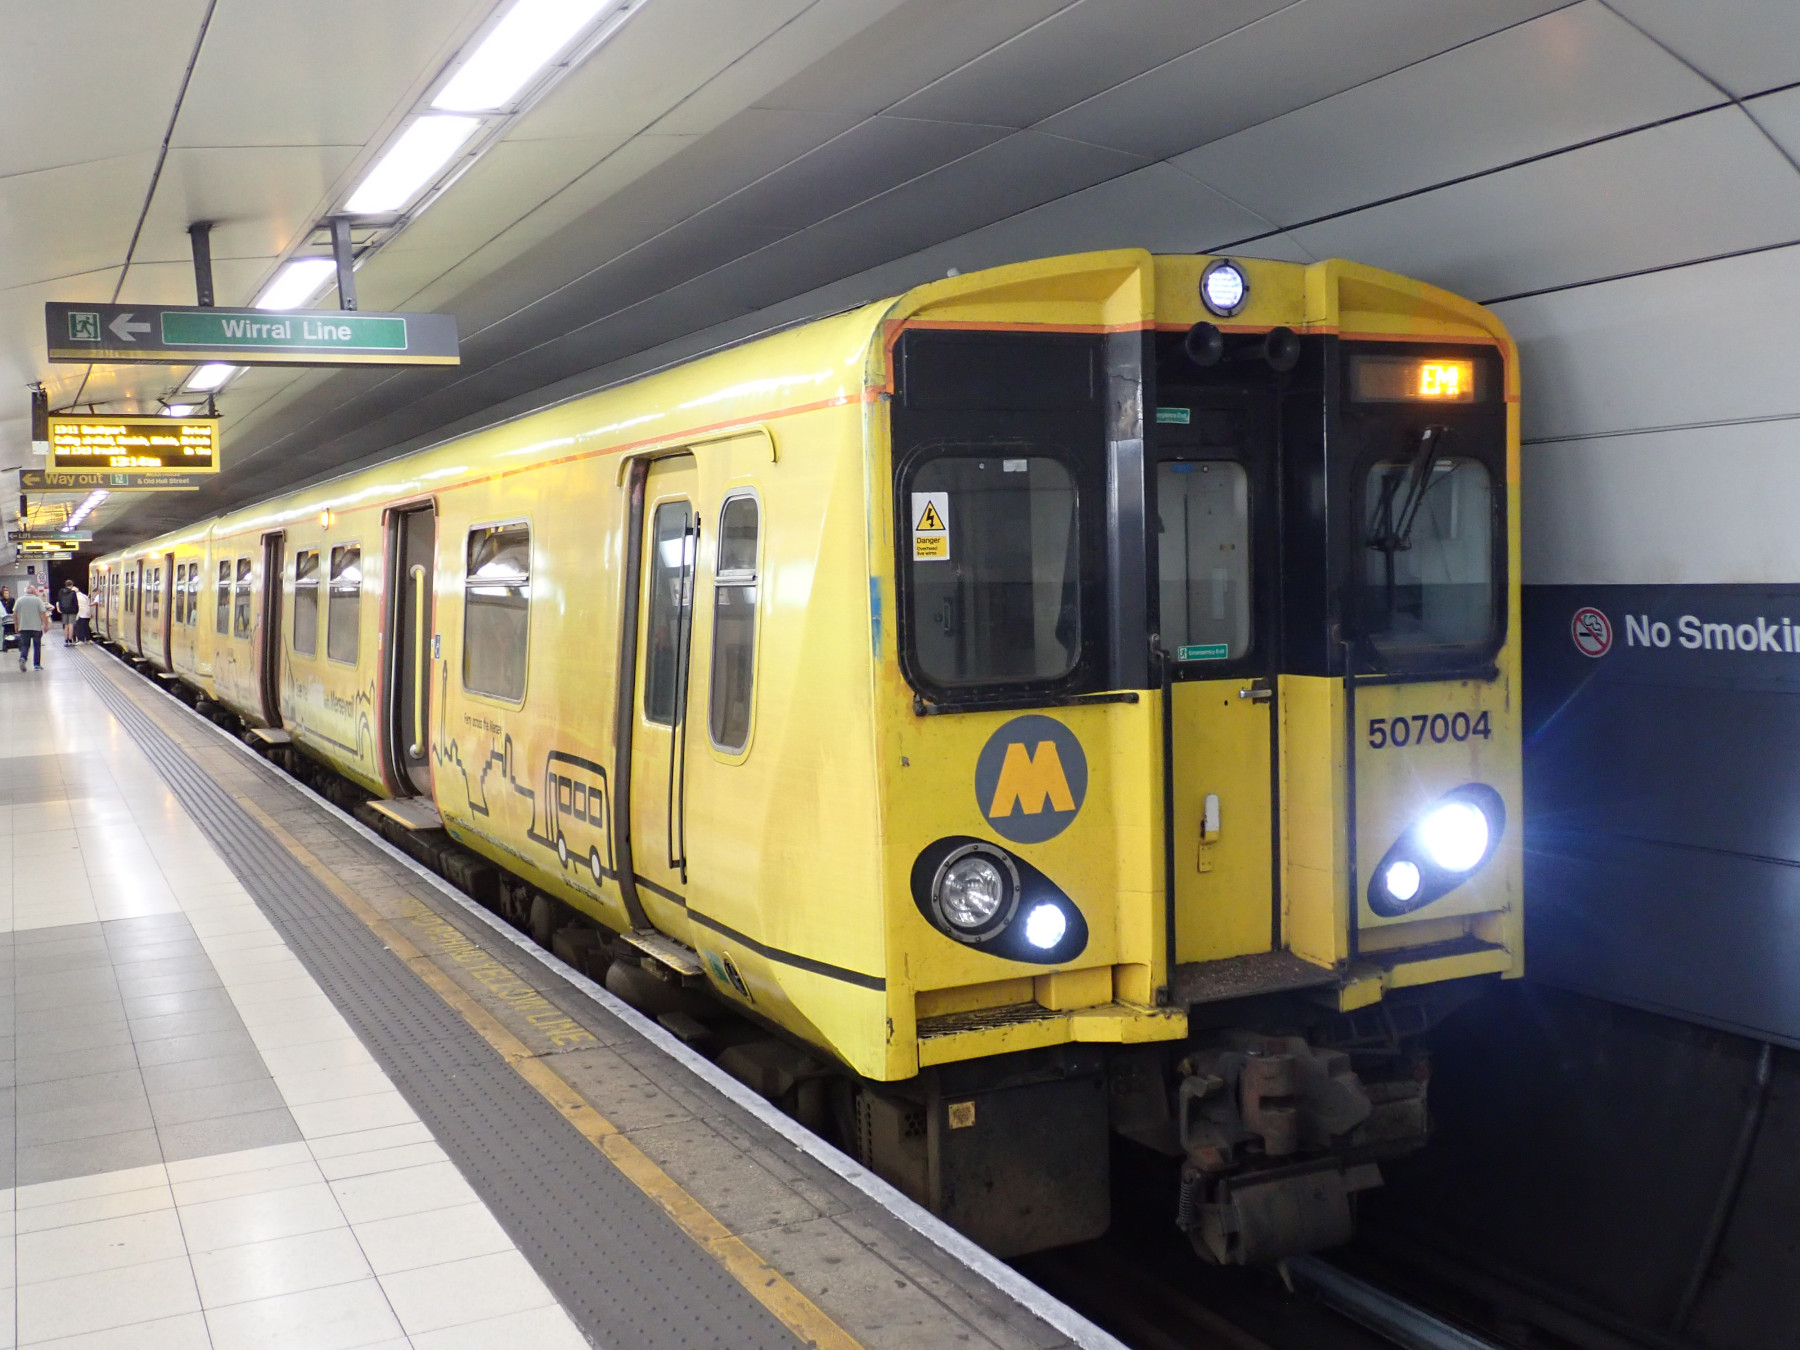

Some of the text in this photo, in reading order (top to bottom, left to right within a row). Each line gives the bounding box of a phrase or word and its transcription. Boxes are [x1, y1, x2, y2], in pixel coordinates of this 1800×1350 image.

[221, 319, 352, 340] Wirral Line
[45, 473, 103, 486] Way out
[1625, 614, 1800, 652] No Smoki
[1368, 711, 1491, 749] 507004
[525, 1011, 596, 1046] LINE
